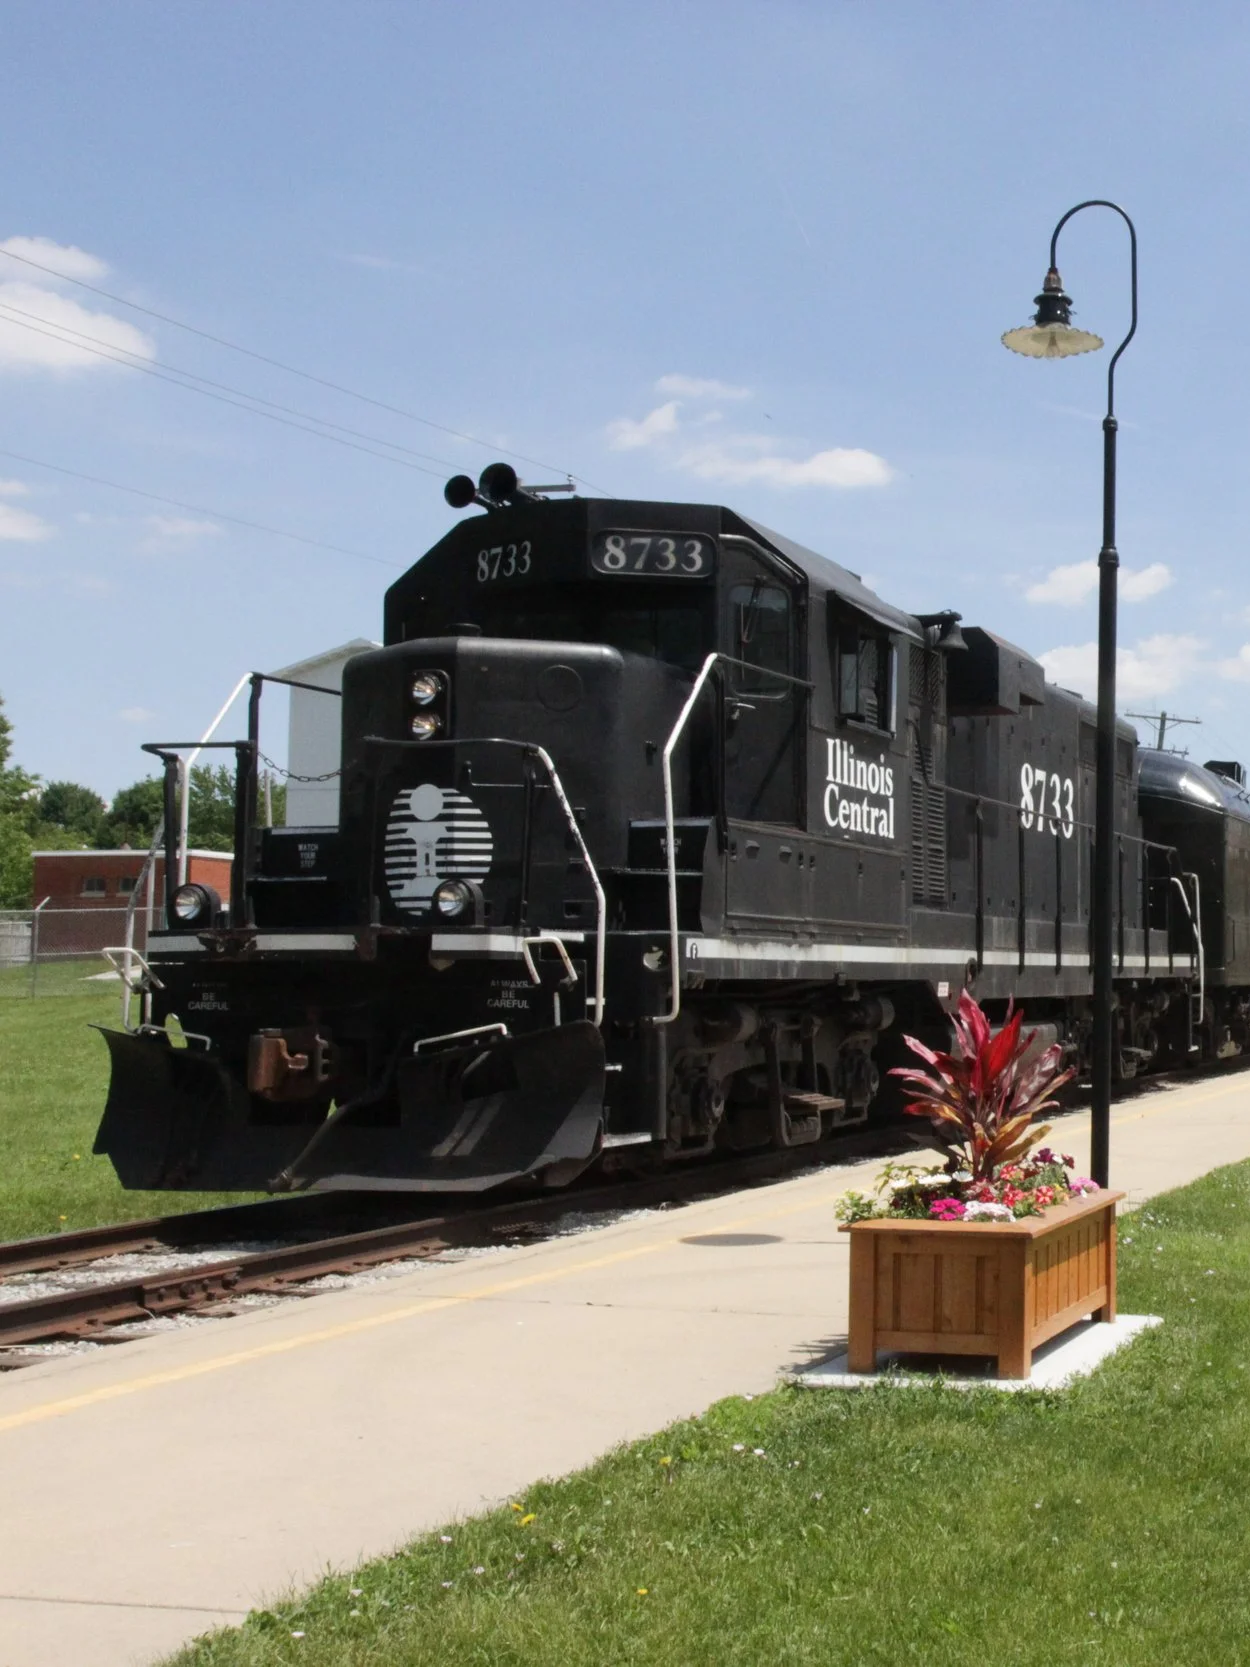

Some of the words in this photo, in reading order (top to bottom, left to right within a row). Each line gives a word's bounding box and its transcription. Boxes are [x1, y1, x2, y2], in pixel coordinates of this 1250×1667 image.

[476, 540, 532, 583] 8733
[603, 535, 704, 573] 8733
[825, 738, 894, 797] Illinois
[823, 783, 895, 840] Central
[1020, 762, 1075, 840] 8733
[297, 843, 319, 852] WATCH
[187, 1001, 229, 1011] CAREFUL
[202, 992, 216, 1001] BE
[486, 999, 530, 1009] CAREFUL
[501, 990, 516, 999] BE
